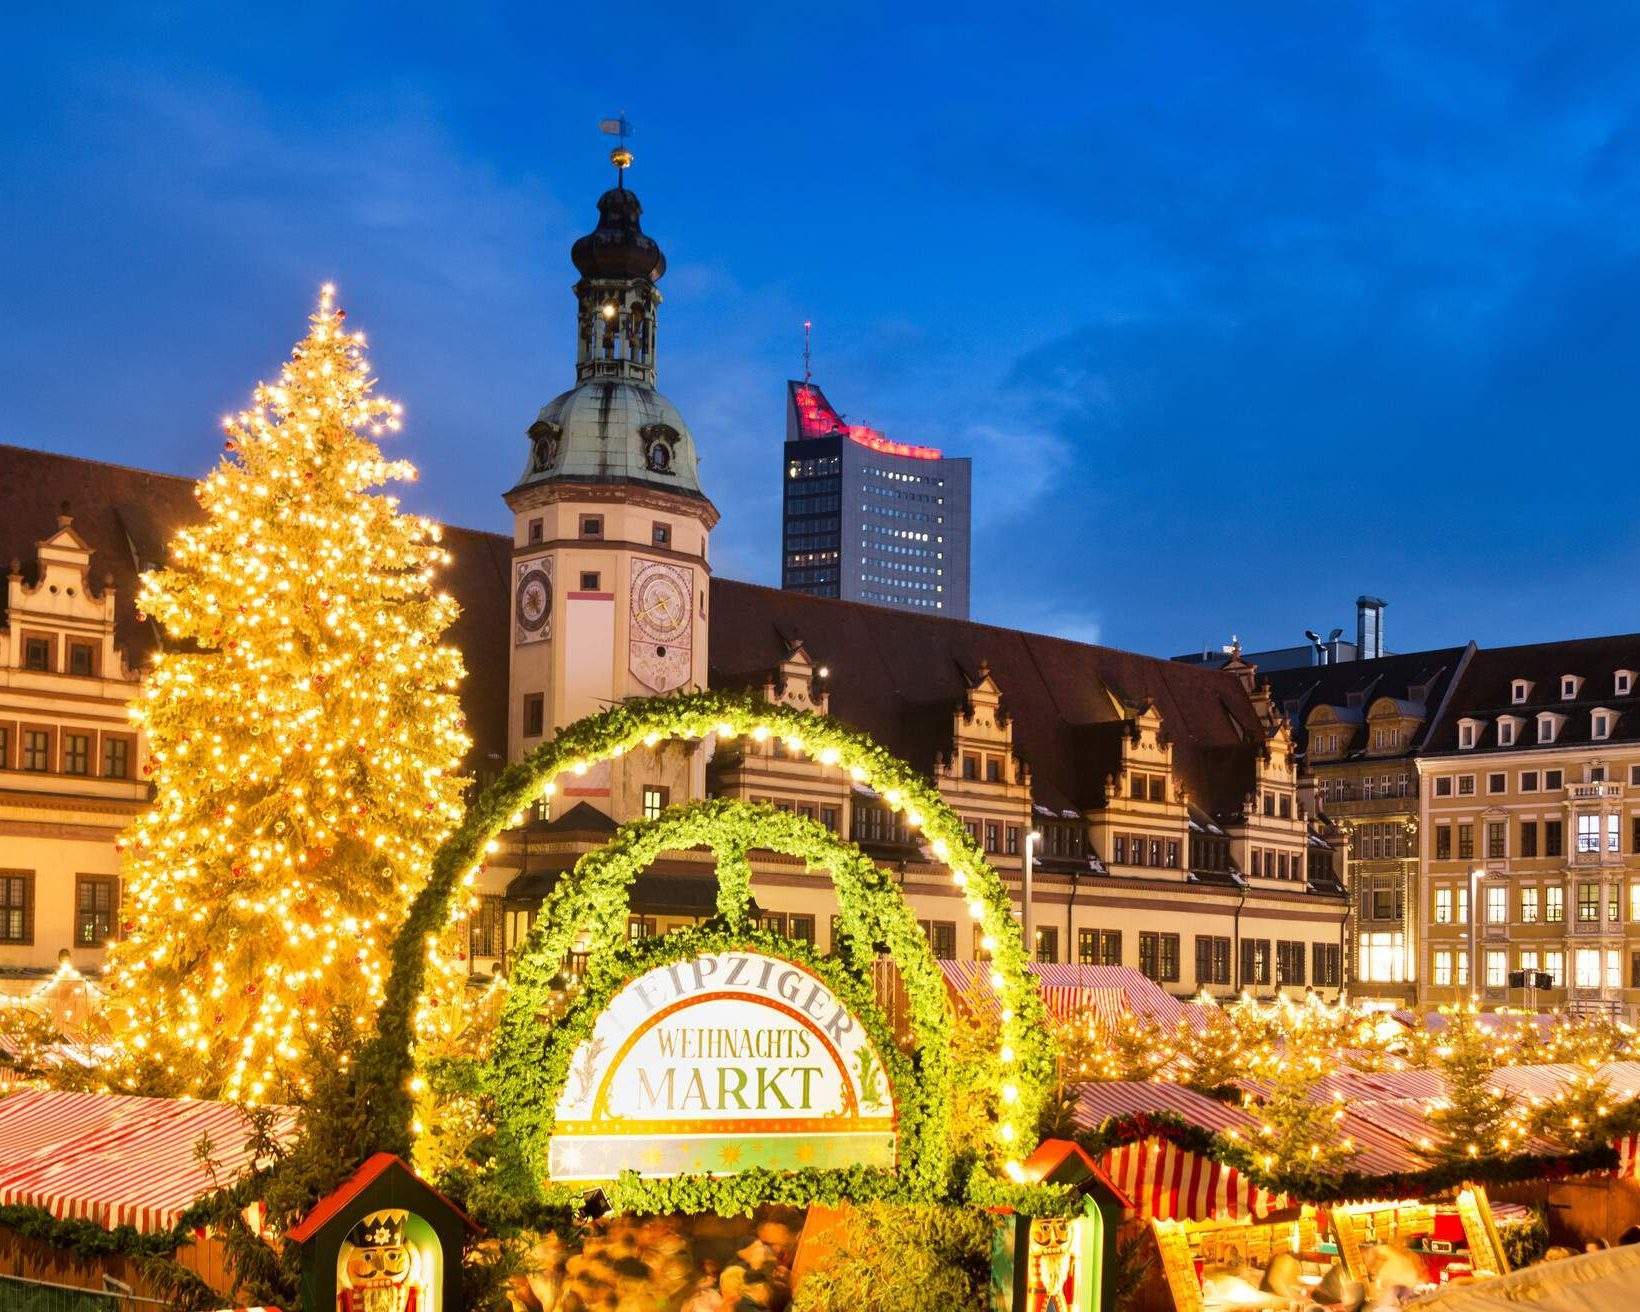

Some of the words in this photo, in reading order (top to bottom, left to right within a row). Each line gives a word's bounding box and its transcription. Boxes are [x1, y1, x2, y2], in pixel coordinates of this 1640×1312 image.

[603, 956, 854, 1049] EIPZIGER
[656, 1028, 811, 1058] WEIHNACHTS
[637, 1067, 824, 1110] MARKT
